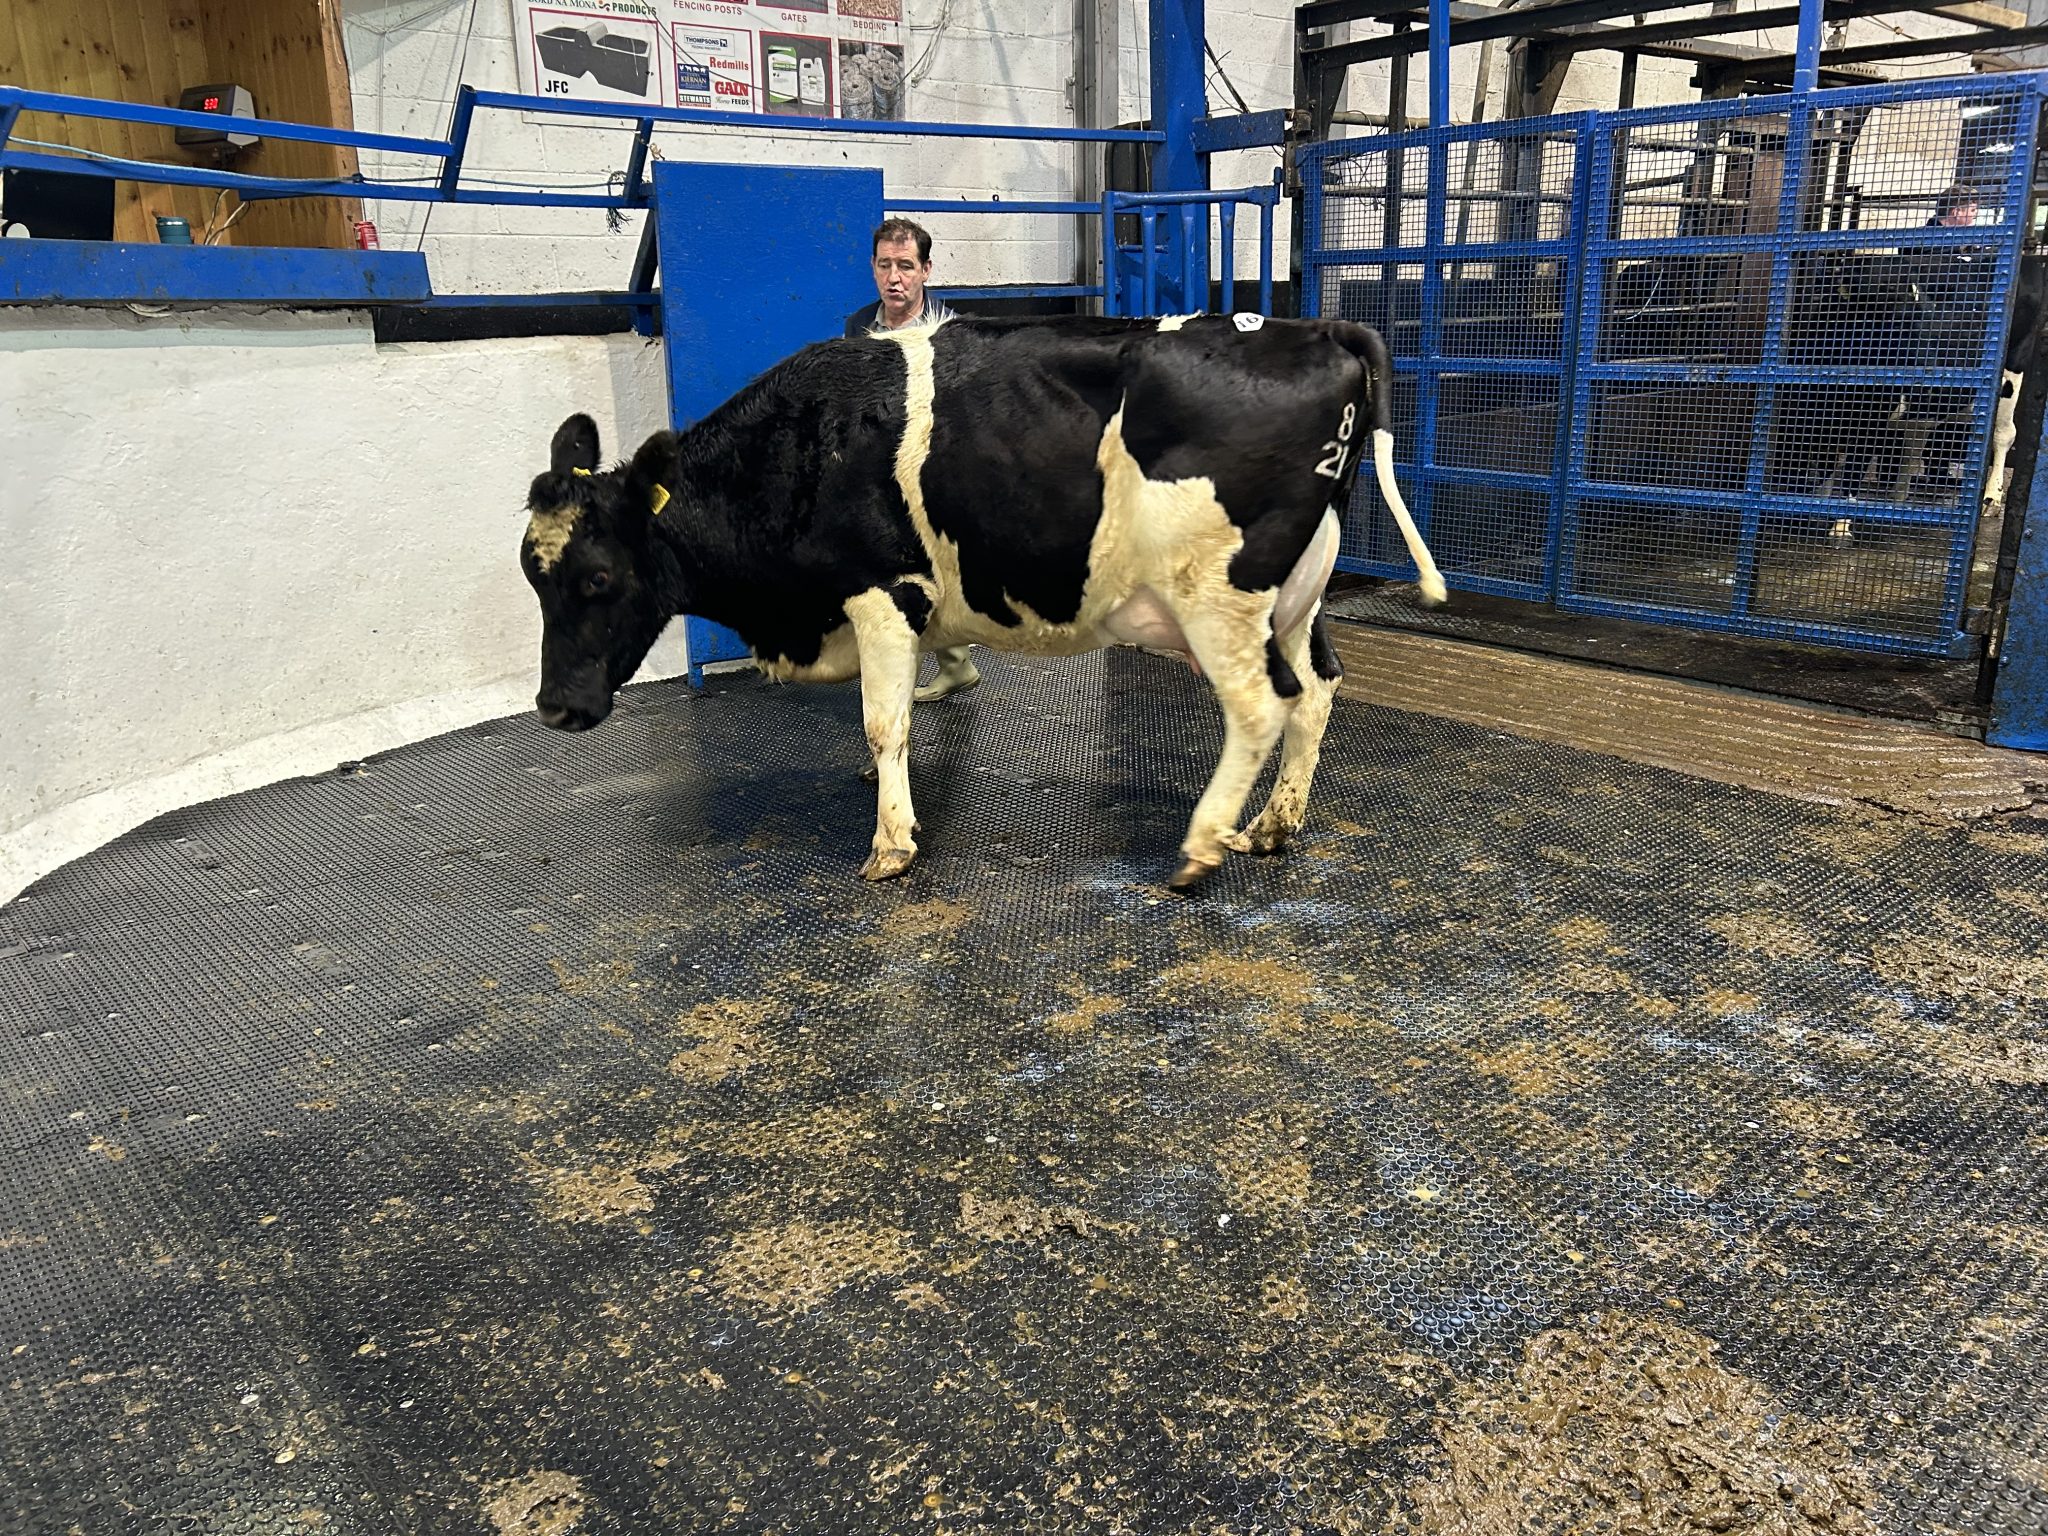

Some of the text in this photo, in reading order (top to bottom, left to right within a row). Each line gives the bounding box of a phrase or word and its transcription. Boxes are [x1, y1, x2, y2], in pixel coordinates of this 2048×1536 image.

[612, 2, 657, 16] PRODUCTS
[674, 0, 742, 16] FENCING POSTS
[781, 12, 808, 23] GATES
[853, 19, 887, 31] BEDDING
[685, 37, 719, 45] THOMPSONS
[709, 57, 748, 70] Redmills
[545, 79, 568, 94] JFC
[715, 82, 748, 96] GAIN
[679, 94, 711, 104] STEWARTS
[731, 98, 749, 106] FEEDS
